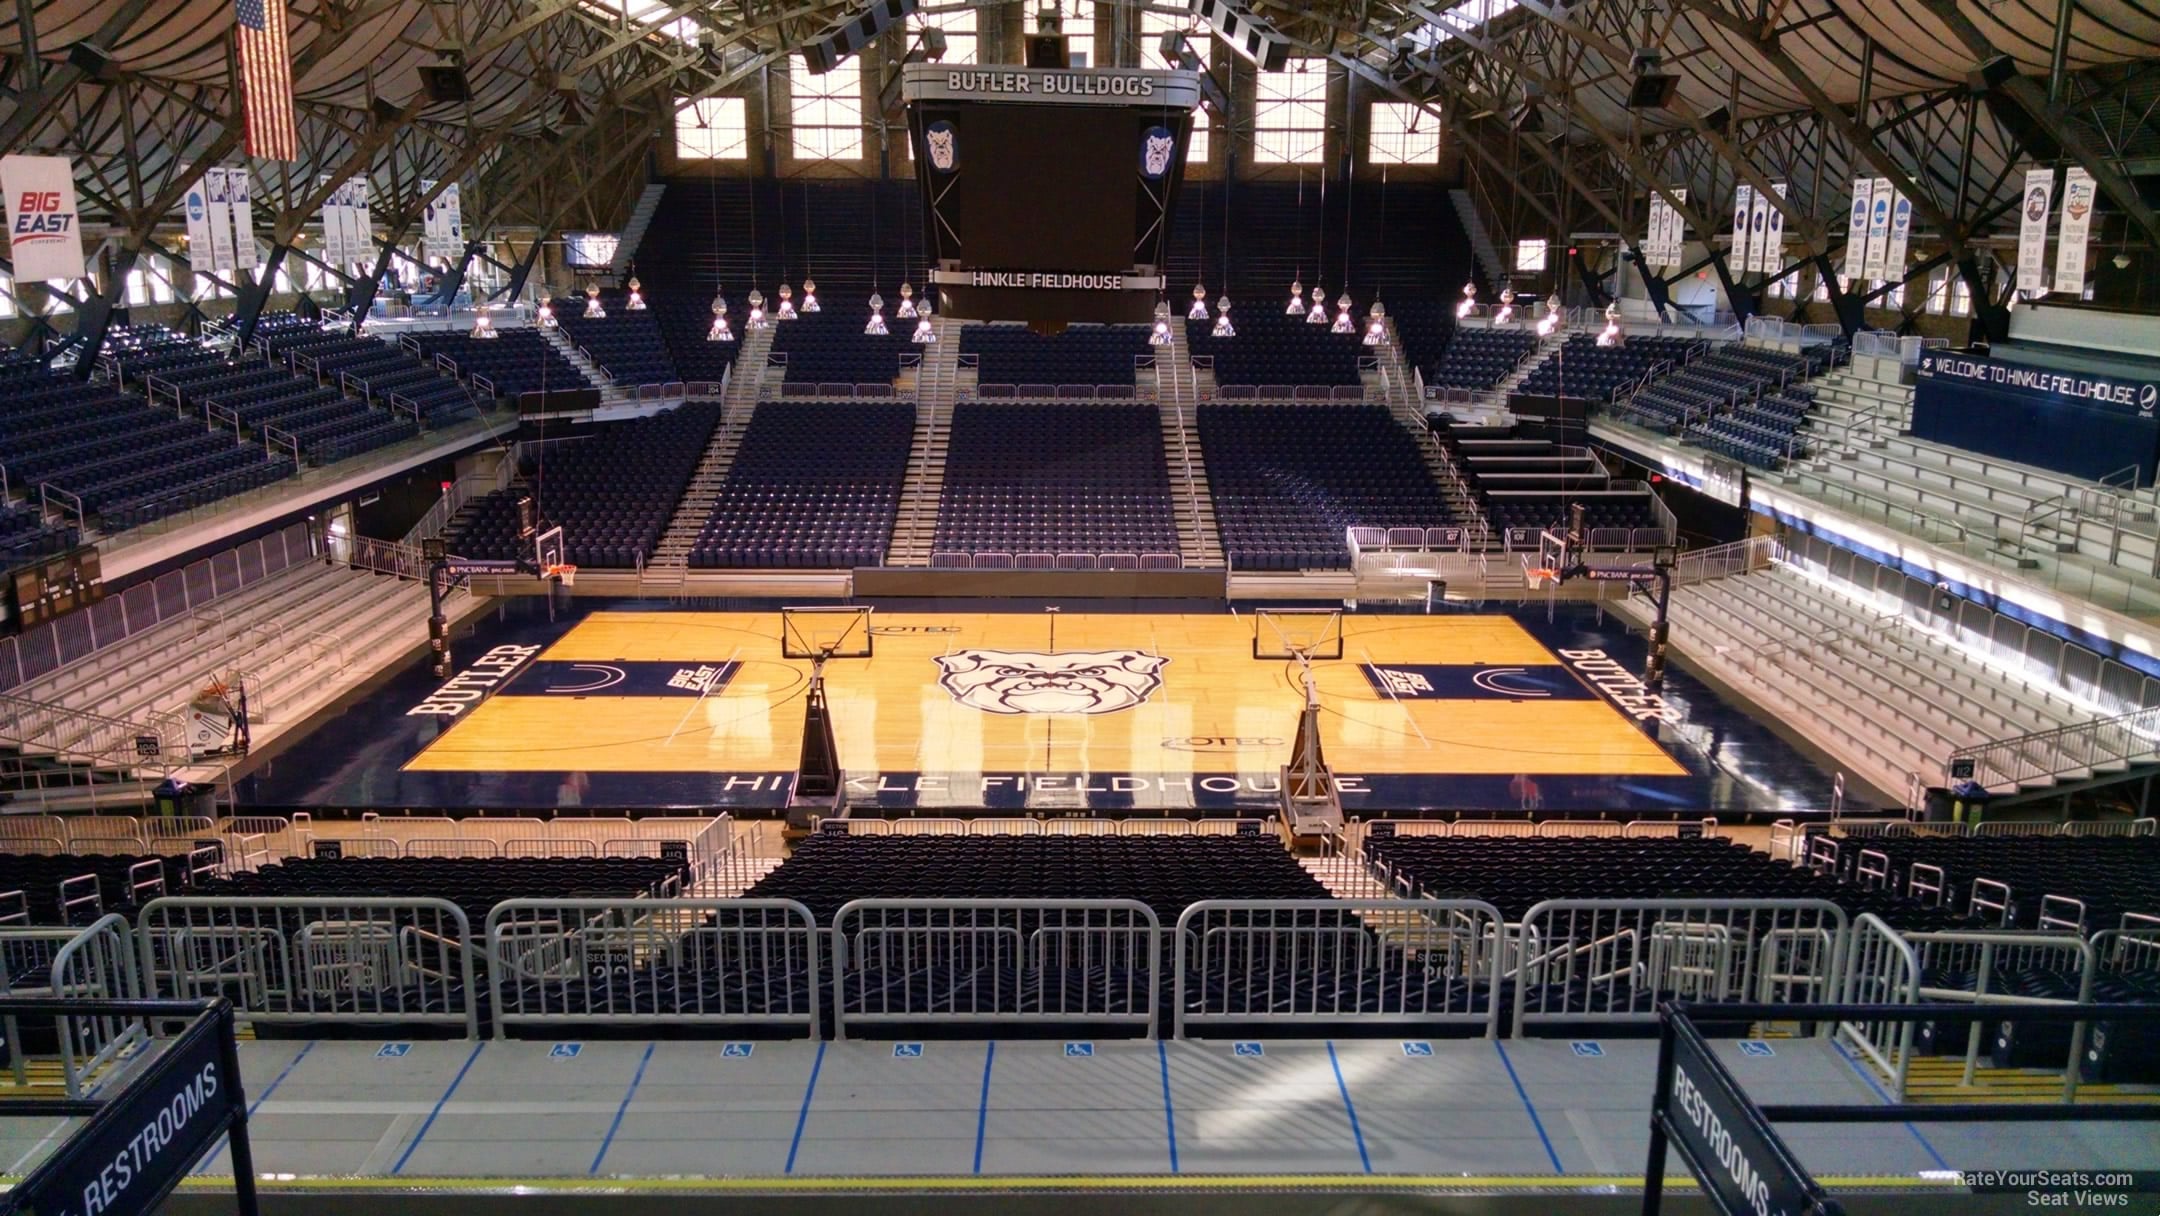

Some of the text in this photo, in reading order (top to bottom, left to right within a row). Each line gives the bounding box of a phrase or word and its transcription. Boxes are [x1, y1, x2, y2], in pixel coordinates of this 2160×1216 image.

[948, 71, 1153, 96] BUTLER BULLDOGS
[19, 191, 60, 212] BIG
[14, 213, 73, 234] EAST
[972, 271, 1121, 290] HINKLE FIELDHOUSE
[1935, 357, 1987, 380] WELCOME
[1990, 366, 2006, 383] TO
[2006, 369, 2050, 391] HINKLE
[2050, 375, 2136, 406] FIELDHOUSE
[405, 644, 542, 716] BUTLER
[666, 669, 696, 689] BIG
[1557, 649, 1683, 724] BUTLER
[723, 776, 1371, 793] HIKLE FIELDHOUE
[84, 1062, 217, 1216] RESTROOMS
[1674, 1064, 1769, 1216] RESTROOMS
